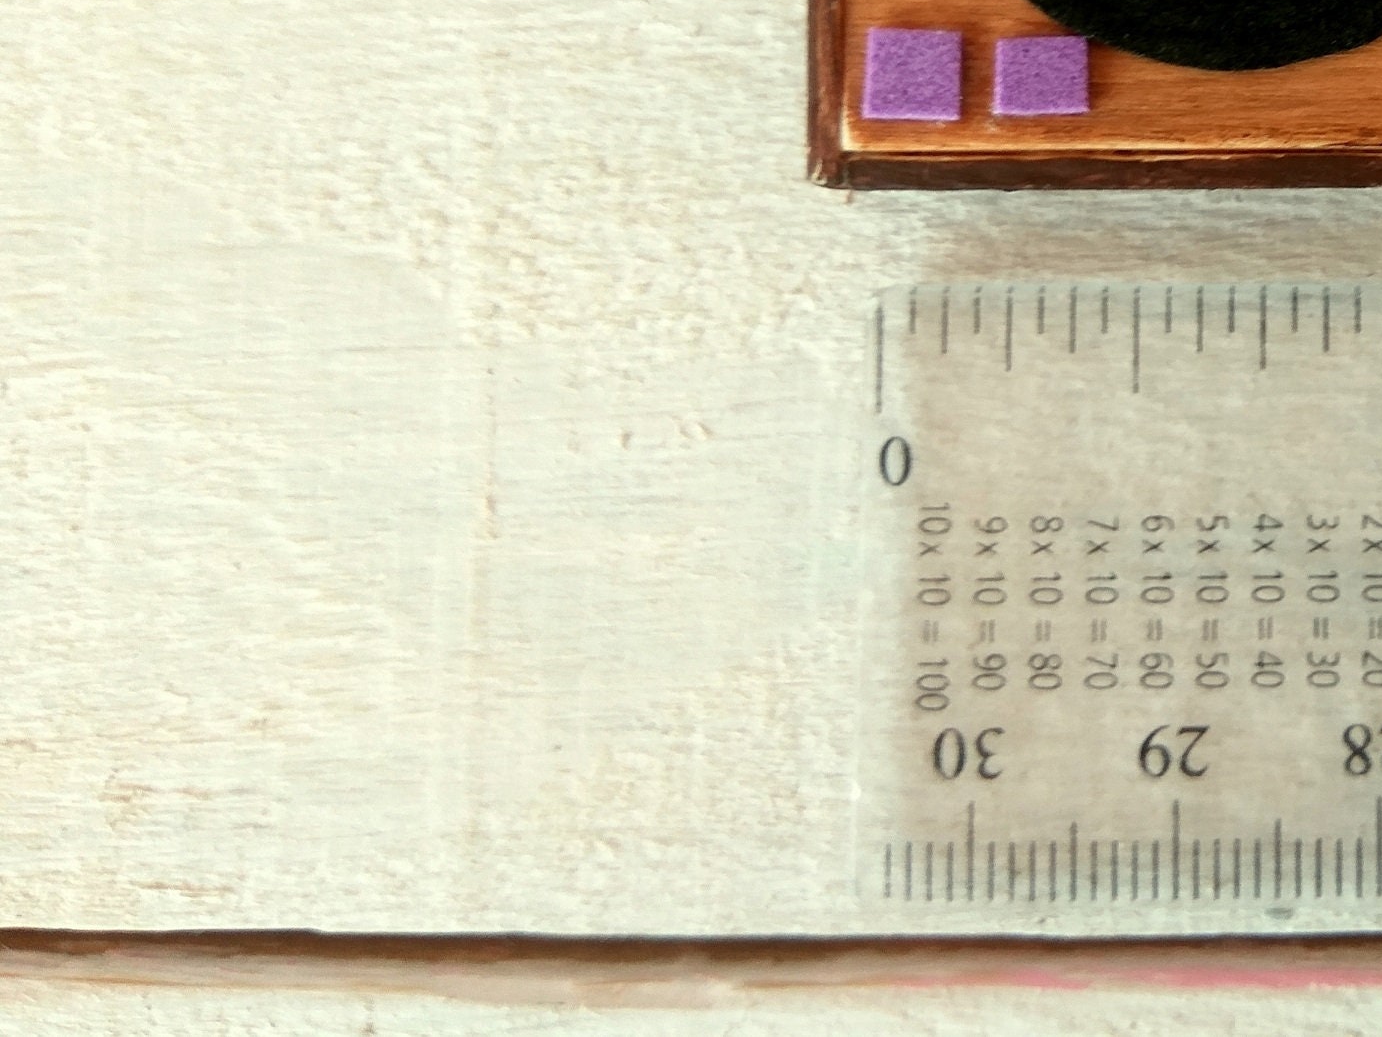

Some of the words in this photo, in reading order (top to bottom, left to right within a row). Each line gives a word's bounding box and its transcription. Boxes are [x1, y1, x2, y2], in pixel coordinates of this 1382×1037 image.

[878, 436, 913, 486] 0
[917, 502, 952, 537] 10
[973, 516, 1008, 536] 9
[1029, 515, 1064, 534] 8
[1086, 517, 1120, 532] 7
[1141, 515, 1175, 533] 6
[1195, 514, 1230, 533] 5
[1253, 513, 1284, 533] 4
[1306, 514, 1339, 531] 3
[916, 574, 952, 608] 10
[972, 572, 1007, 607] 10
[1028, 573, 1064, 607] 10
[1084, 573, 1119, 606] 10
[1139, 571, 1174, 605] 10
[1195, 571, 1229, 606] 10
[1251, 571, 1285, 604] 10
[1306, 570, 1340, 604] 10
[911, 658, 950, 713] 100
[971, 653, 1007, 691] 90
[1027, 653, 1062, 691] 80
[1083, 653, 1118, 691] 70
[1139, 652, 1174, 690] 60
[1194, 653, 1230, 690] 50
[1250, 651, 1285, 689] 40
[1306, 651, 1340, 689] 30
[929, 727, 1005, 781] 30
[1137, 725, 1210, 779] 29
